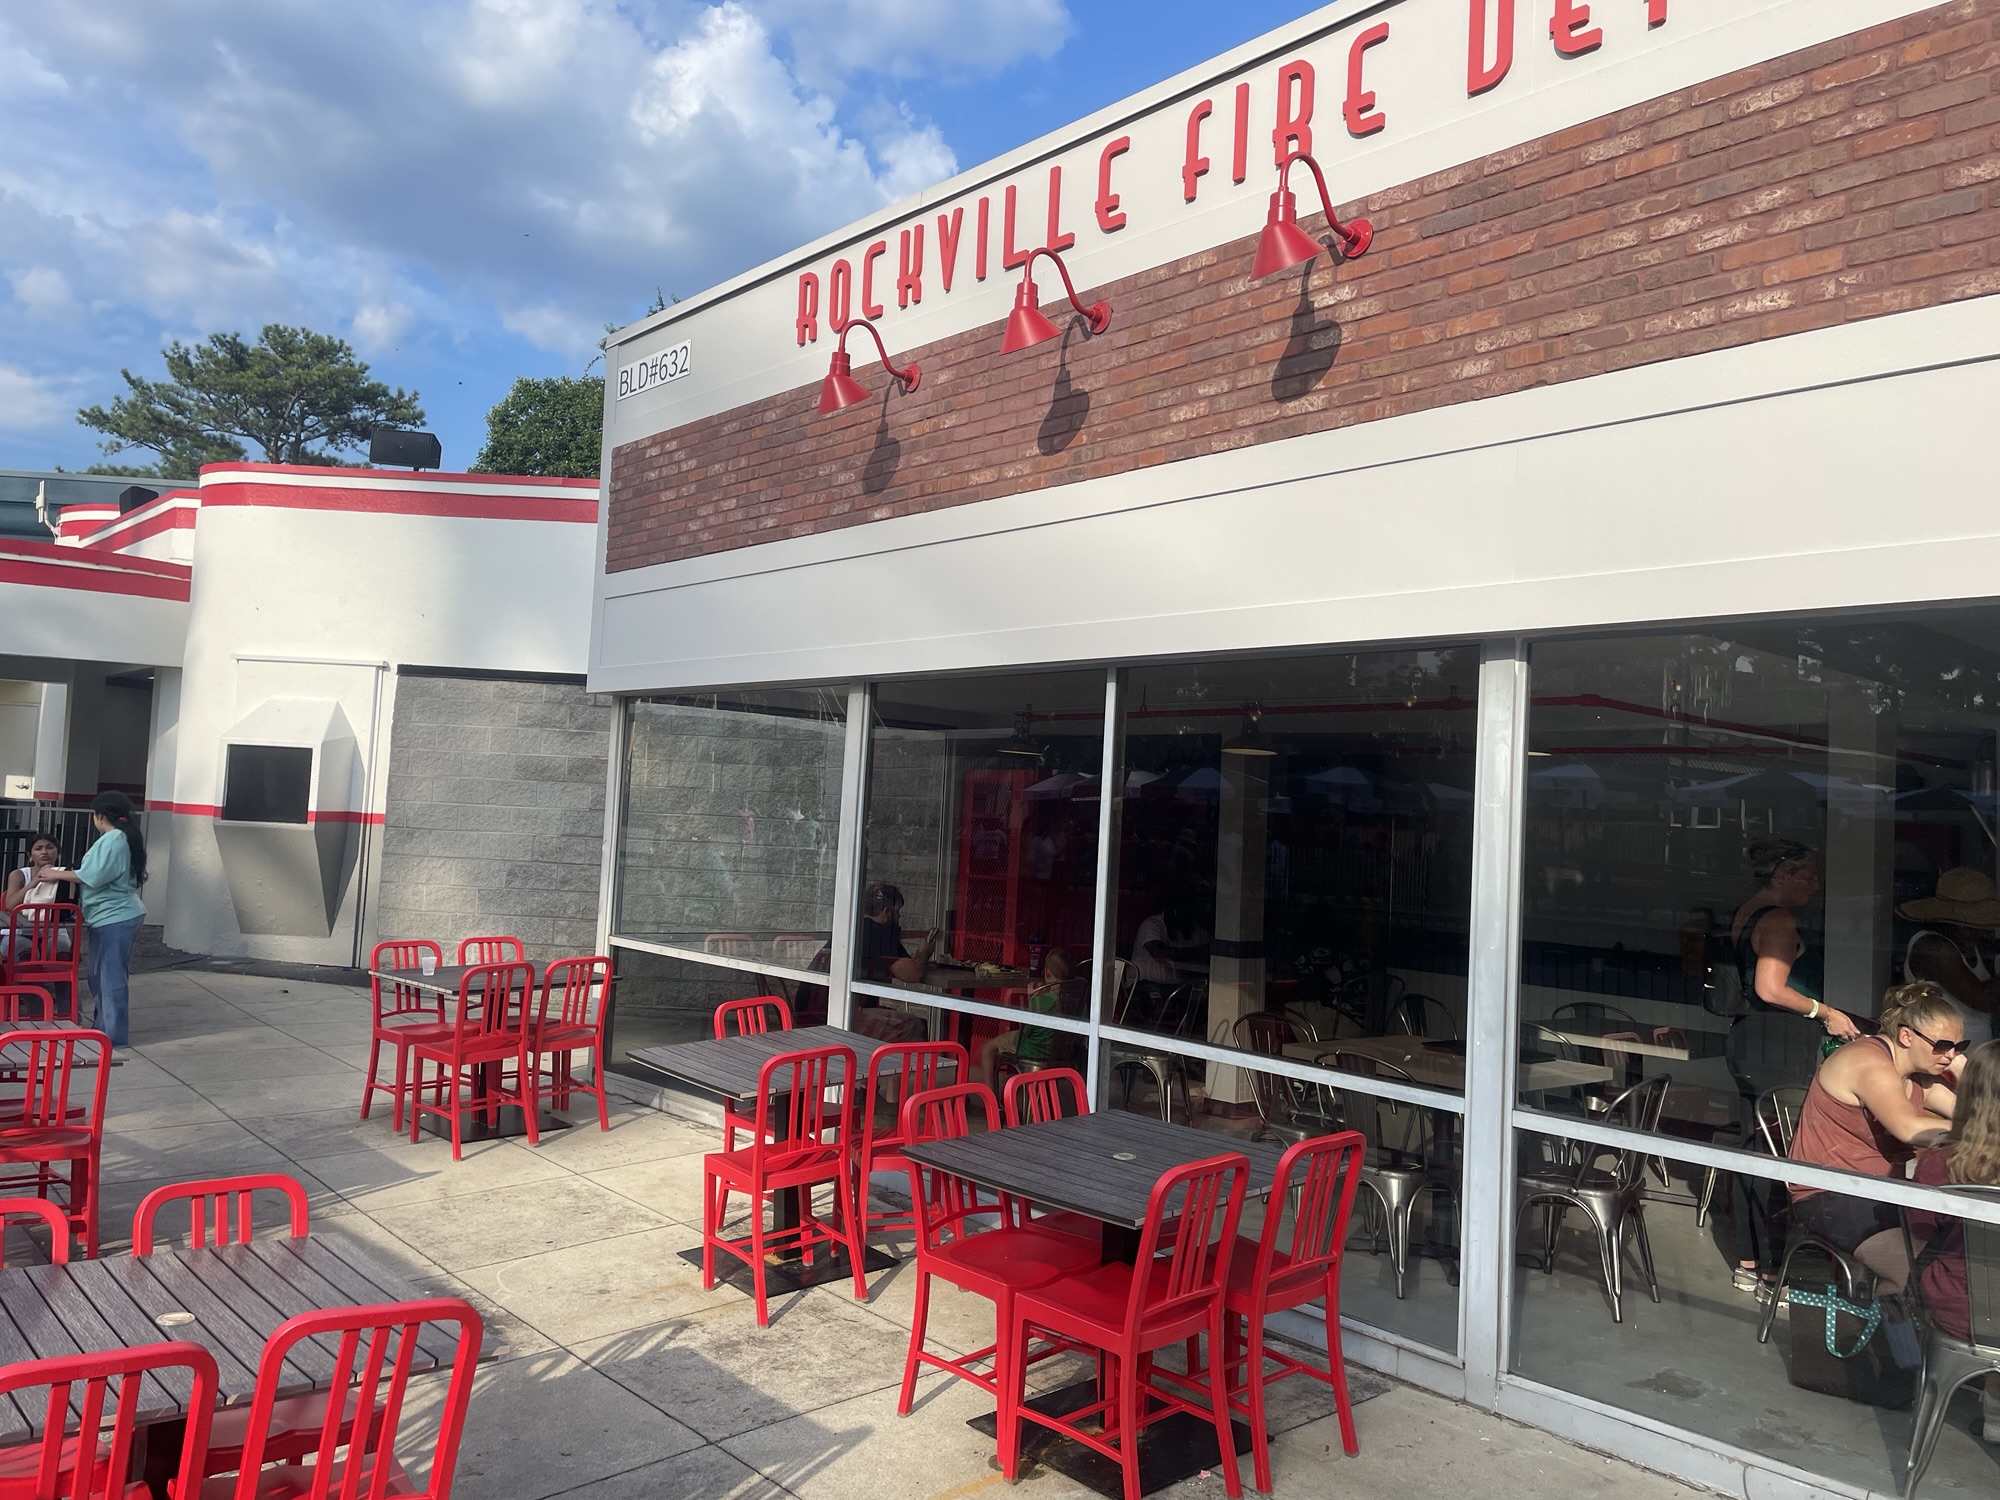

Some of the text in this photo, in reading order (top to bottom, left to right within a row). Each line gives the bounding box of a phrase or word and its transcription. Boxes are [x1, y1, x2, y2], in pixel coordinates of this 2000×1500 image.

[796, 136, 1131, 344] ROCKVILLE
[1182, 22, 1389, 200] FIRE
[620, 345, 689, 397] BLD#632
